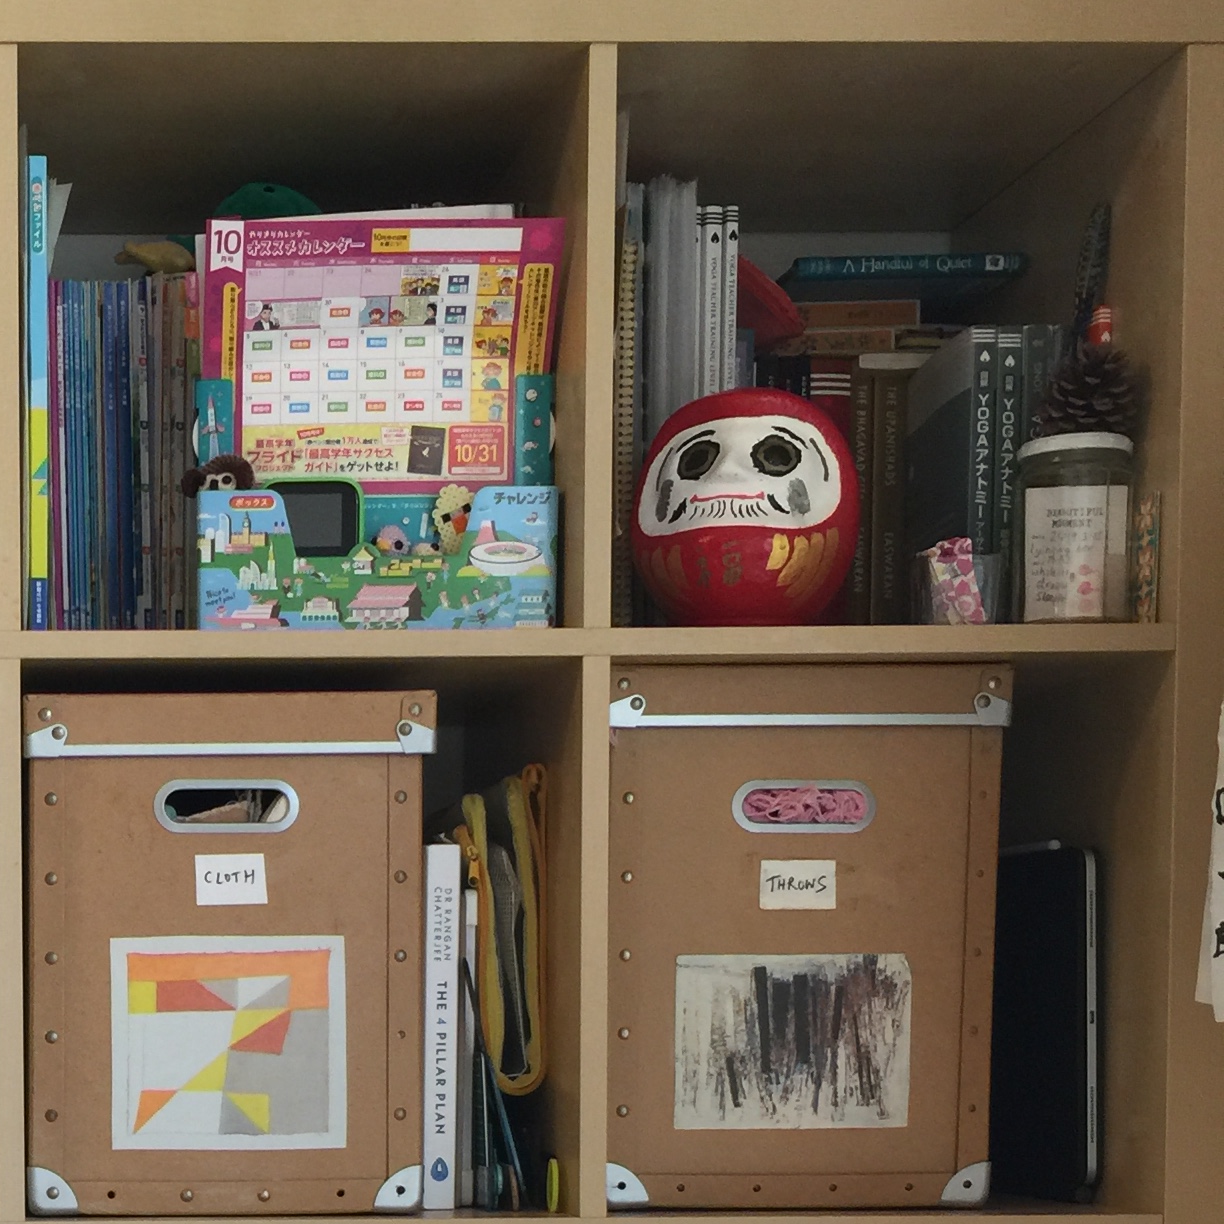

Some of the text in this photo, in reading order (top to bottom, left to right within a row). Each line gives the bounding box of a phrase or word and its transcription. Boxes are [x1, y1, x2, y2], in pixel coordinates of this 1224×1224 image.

[213, 230, 242, 254] 10
[246, 236, 366, 256] オススメカレンダー
[860, 256, 913, 273] Handful
[918, 258, 929, 269] of
[936, 255, 972, 273] Quiet
[454, 443, 497, 463] 10/31
[974, 393, 990, 518] YOGAアナトミー
[999, 397, 1015, 522] YOGAアナトミー
[235, 497, 268, 507] ボックス
[493, 491, 551, 505] チャレンジ
[203, 869, 256, 885] CLOTH
[766, 873, 827, 894] THROWS
[432, 886, 442, 963] CHATTERJEE
[443, 887, 452, 962] DR RANGAN
[435, 981, 448, 1135] THE 4 PILLAR PLAN
